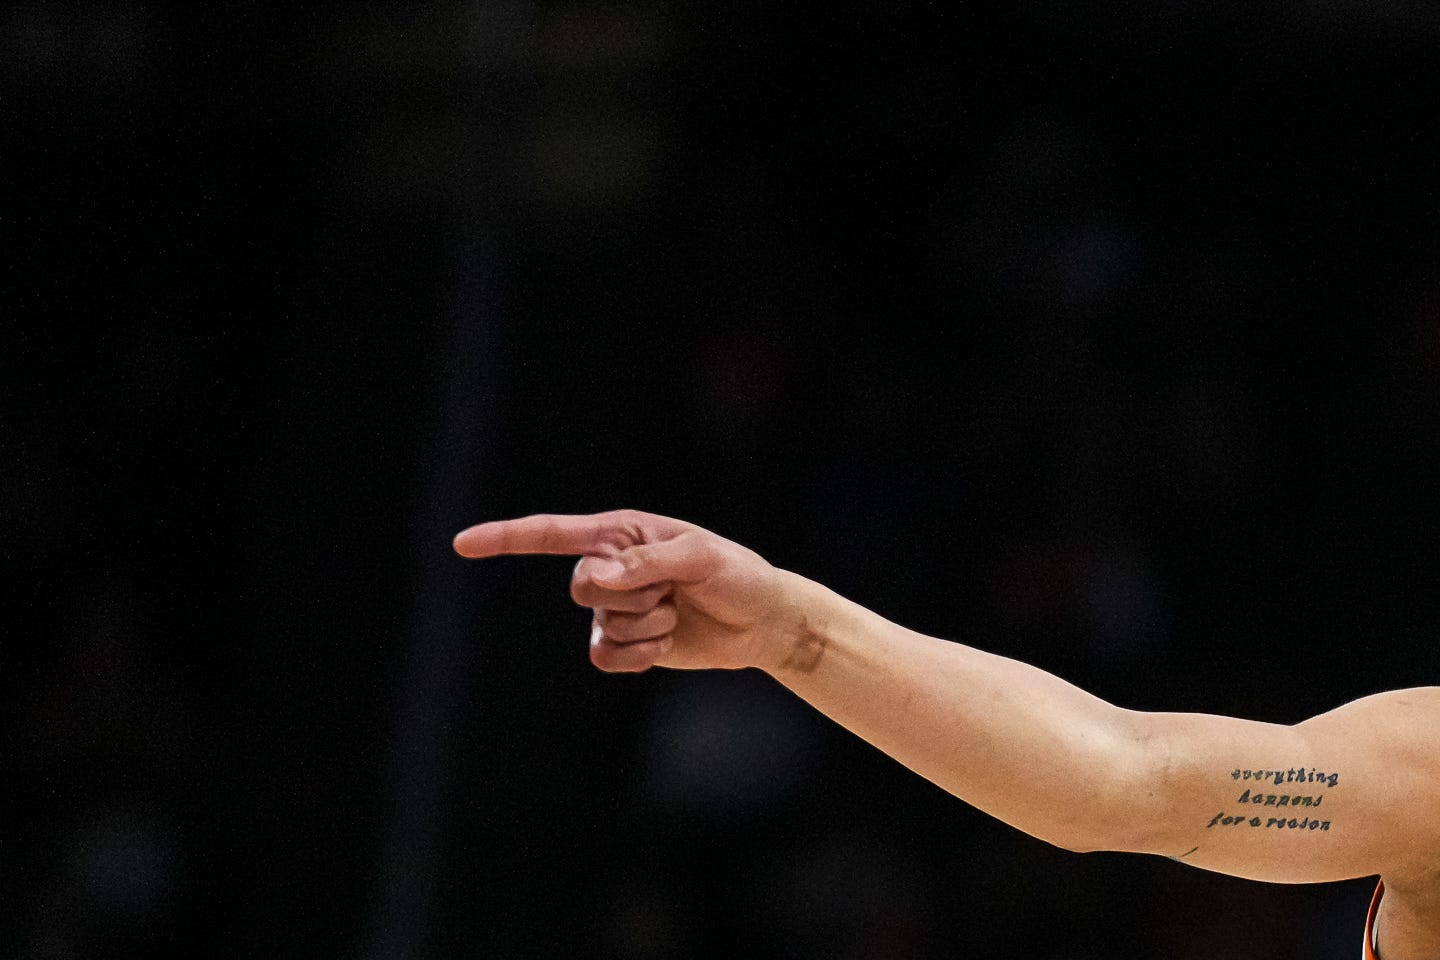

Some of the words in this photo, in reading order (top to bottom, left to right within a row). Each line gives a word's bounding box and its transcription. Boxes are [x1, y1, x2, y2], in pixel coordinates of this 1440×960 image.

[1231, 767, 1339, 788] everything
[1238, 789, 1324, 809] happens
[1206, 812, 1246, 829] for
[1249, 816, 1262, 828] a
[1266, 817, 1332, 832] reason
